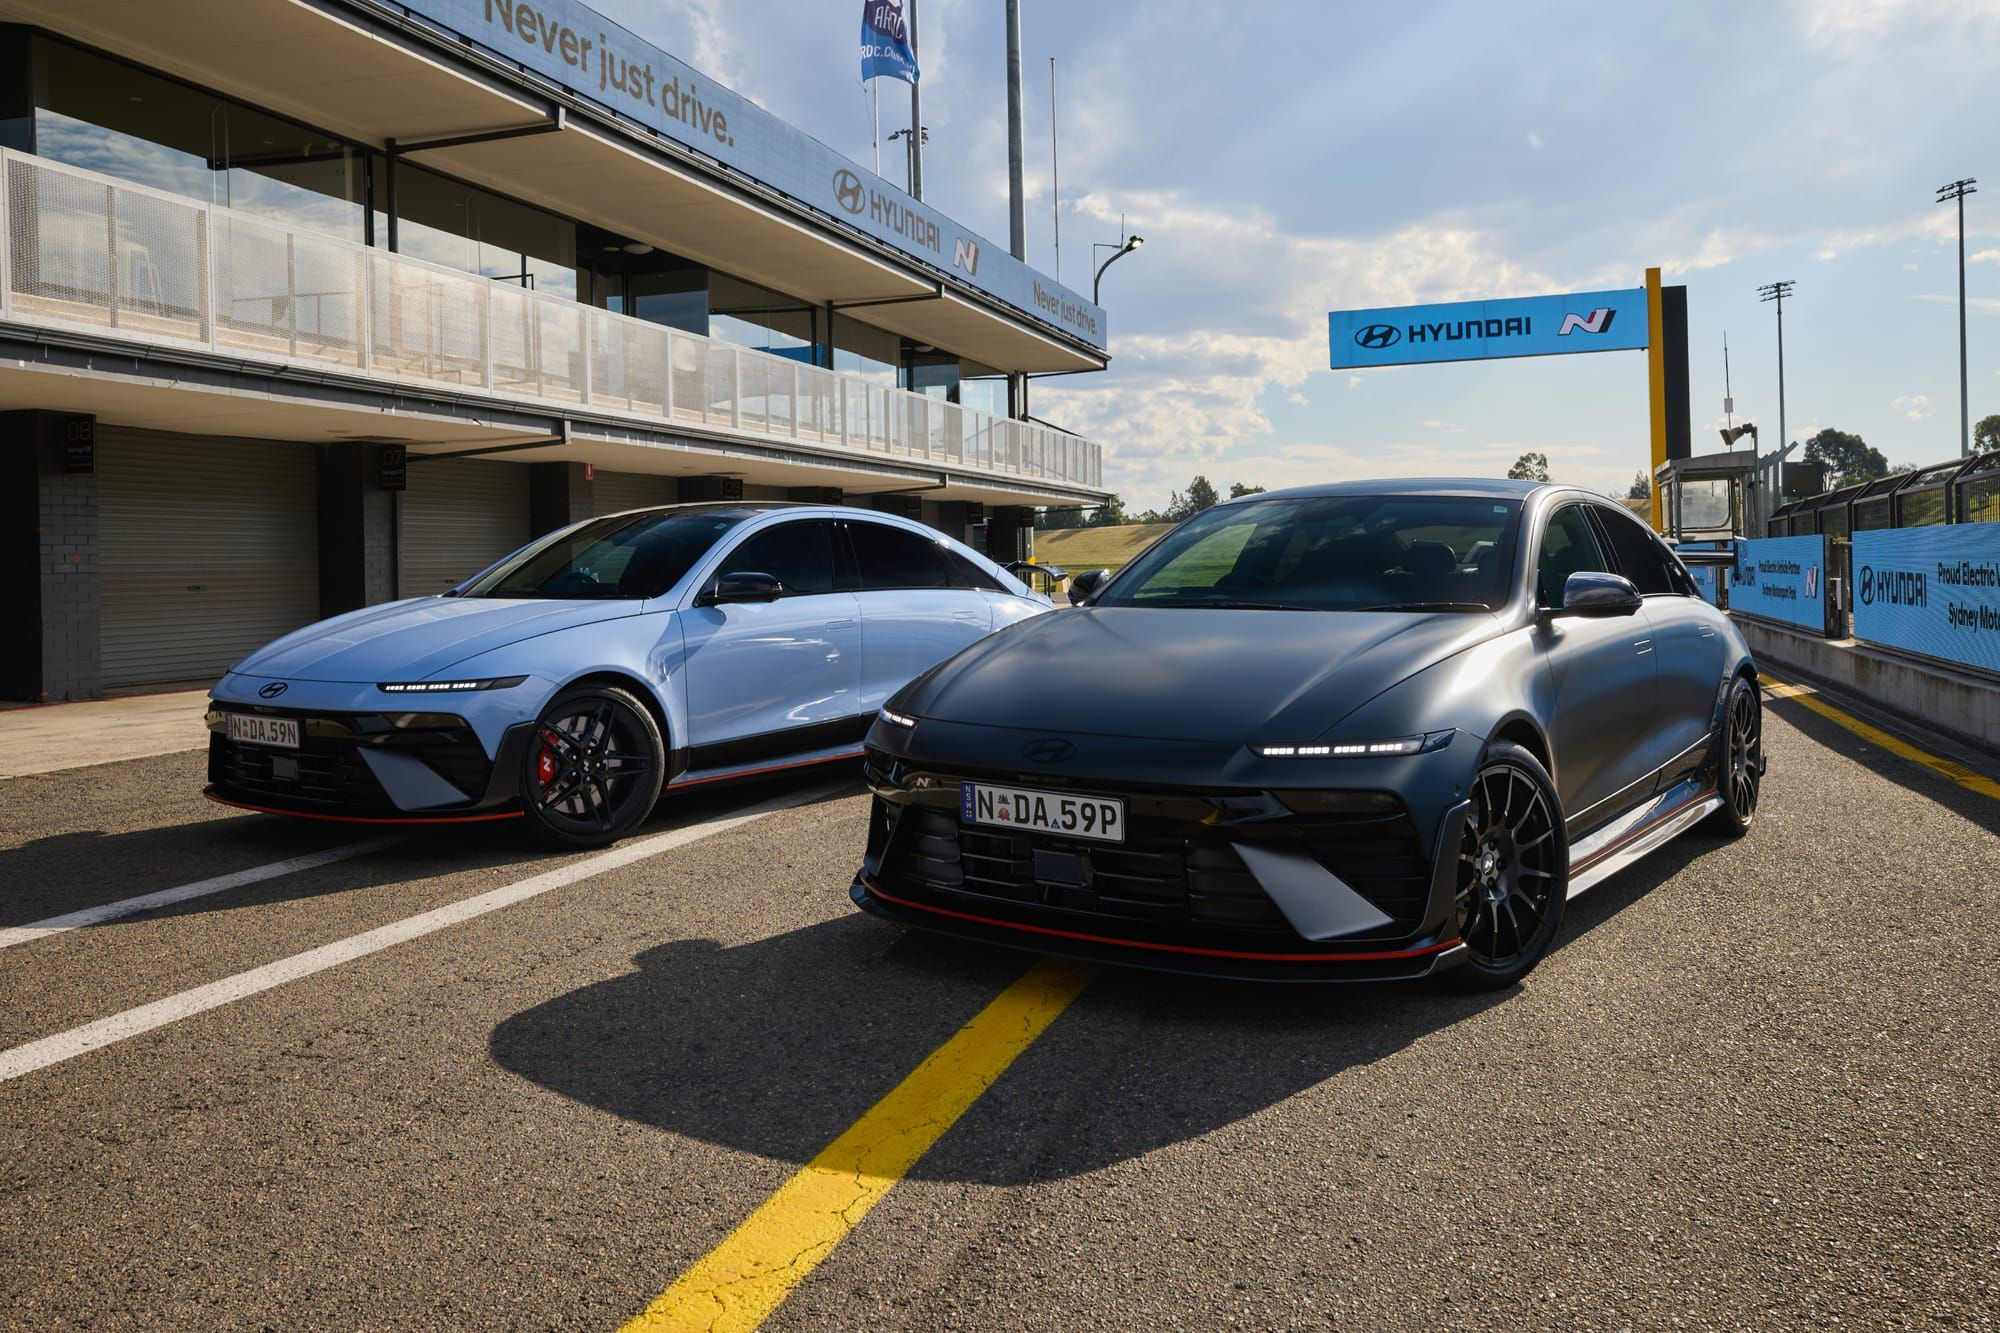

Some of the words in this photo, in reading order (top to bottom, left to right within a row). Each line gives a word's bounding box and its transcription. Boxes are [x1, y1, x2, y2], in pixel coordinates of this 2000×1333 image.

[484, 0, 592, 72] Never
[598, 33, 655, 107] just
[662, 76, 734, 148] drive.
[870, 188, 940, 254] HYUNDAI
[1033, 280, 1059, 316] Never
[1061, 294, 1076, 325] just
[1076, 306, 1098, 337] drive.
[1408, 317, 1531, 343] HYUNDAI
[1877, 570, 1927, 608] HYUNDAI
[1937, 561, 1960, 585] Proud
[1962, 561, 1995, 588] Electric
[1948, 602, 1979, 633] Sydney
